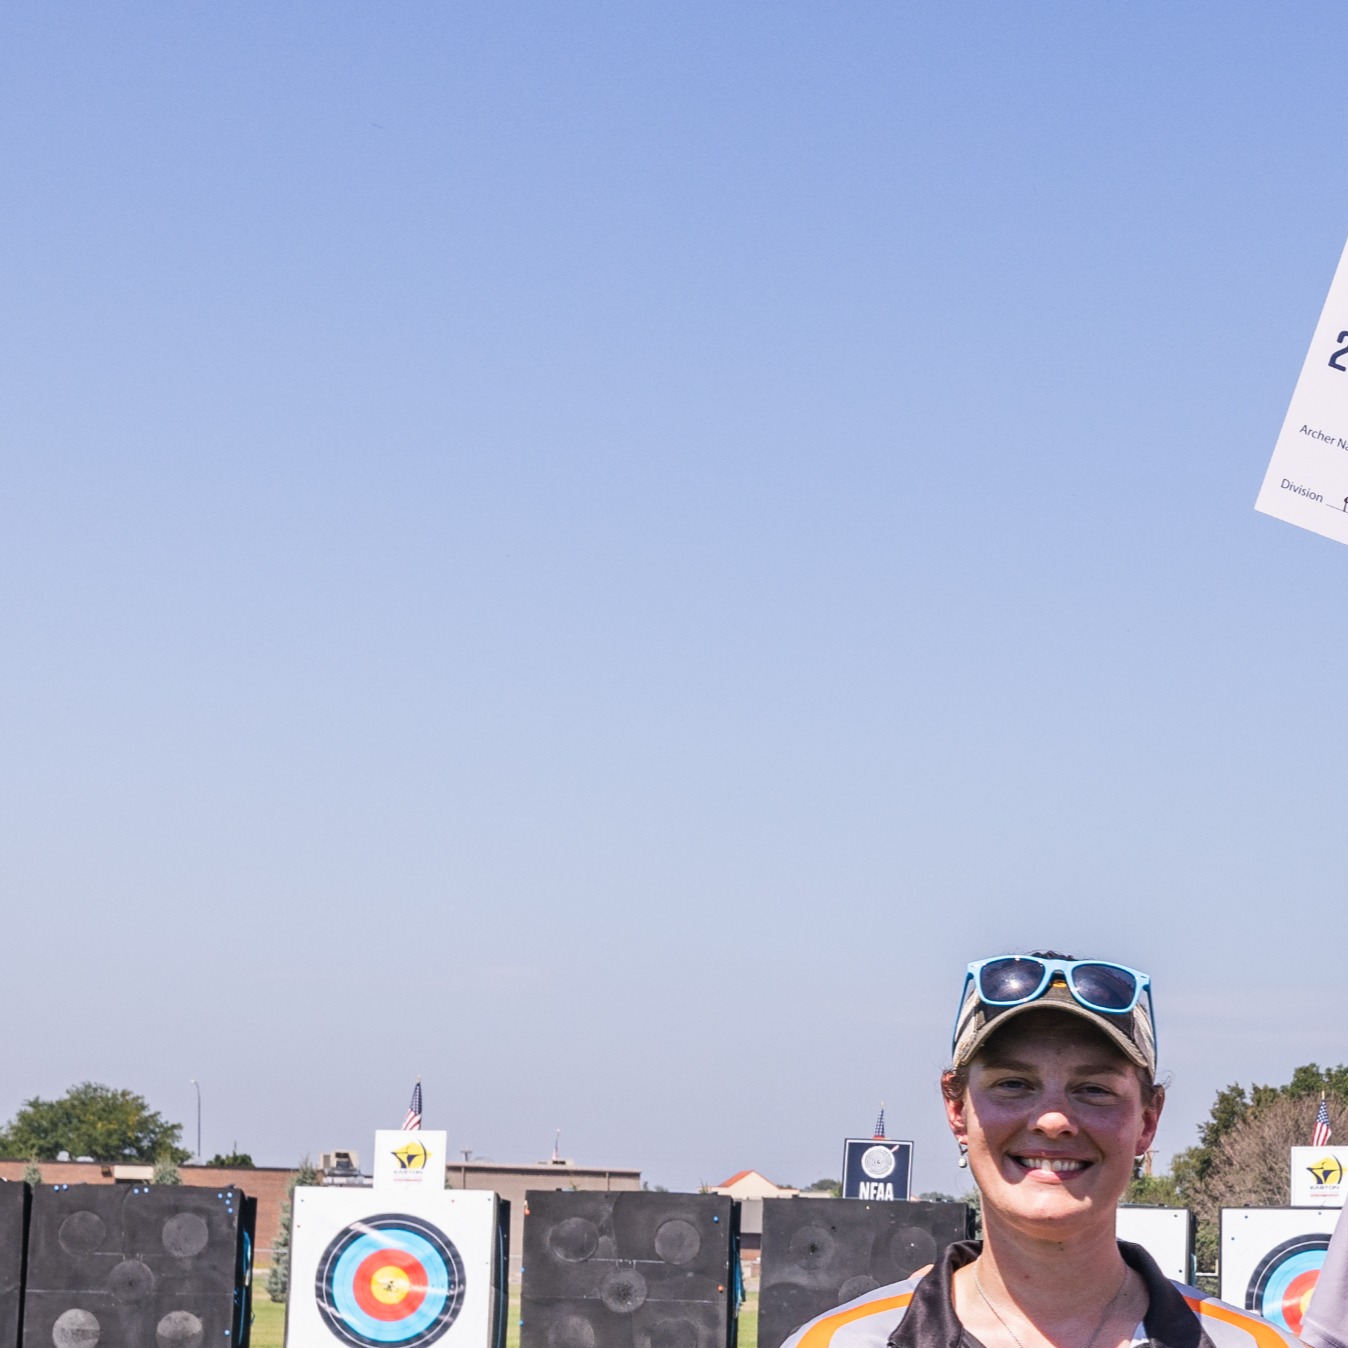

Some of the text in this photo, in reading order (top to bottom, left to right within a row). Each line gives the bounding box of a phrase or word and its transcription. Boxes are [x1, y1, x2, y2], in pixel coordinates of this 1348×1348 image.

[1300, 424, 1336, 449] Archer
[1280, 478, 1323, 503] Division
[859, 1181, 894, 1201] NFAA
